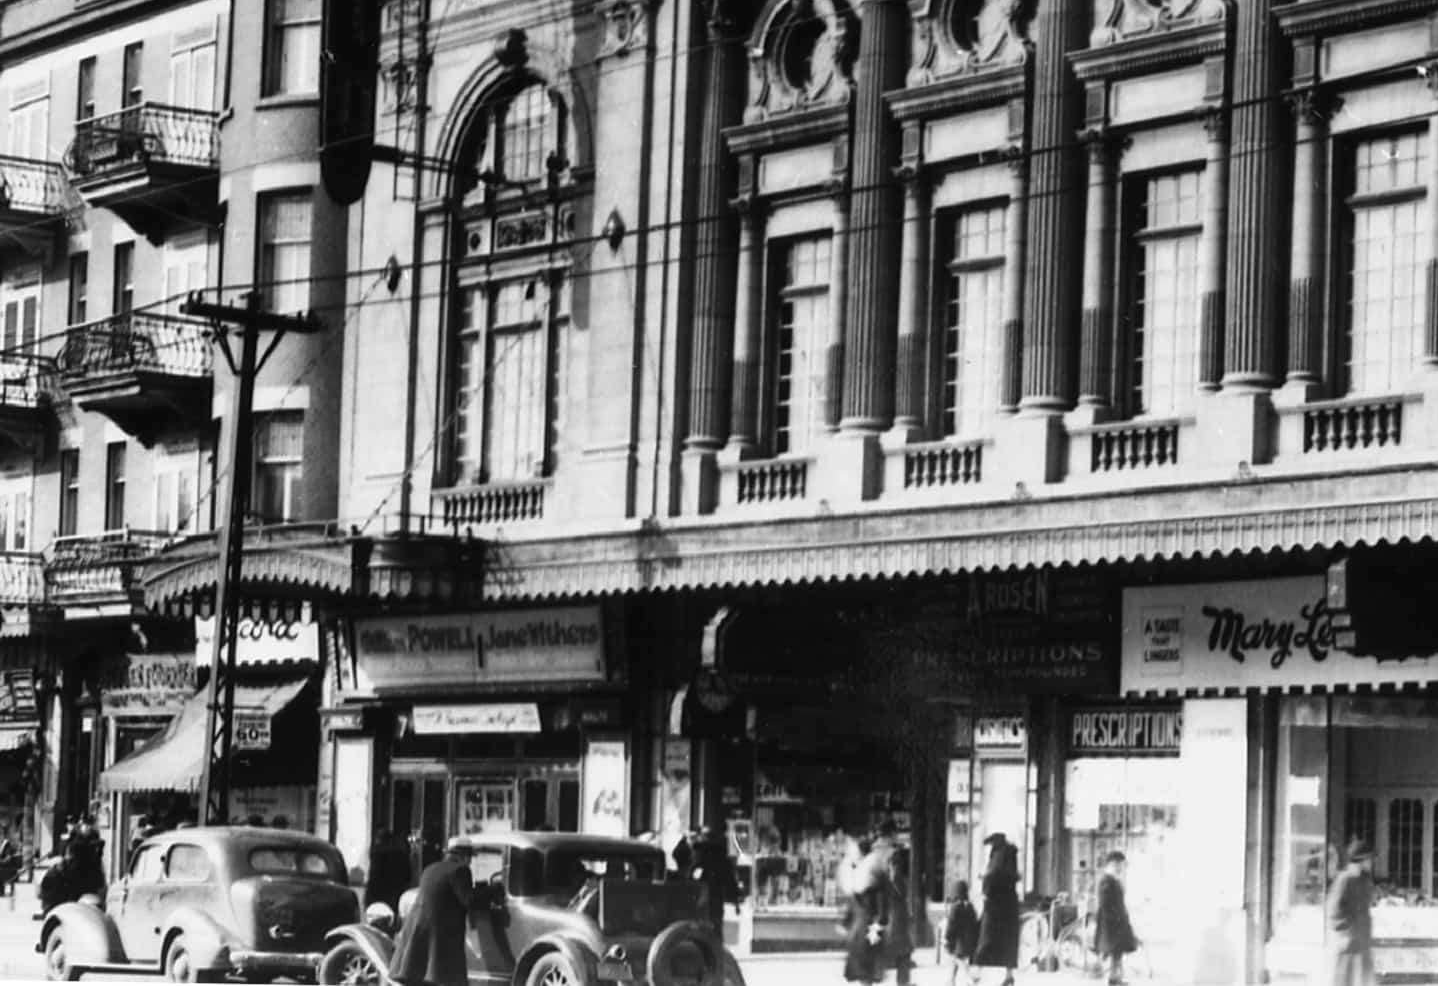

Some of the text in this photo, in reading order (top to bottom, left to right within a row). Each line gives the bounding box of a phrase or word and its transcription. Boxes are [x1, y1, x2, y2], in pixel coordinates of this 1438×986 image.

[985, 567, 1049, 615] ROSEN
[406, 625, 474, 654] POWELL
[1144, 618, 1153, 634] A
[1202, 597, 1337, 669] Mary Le
[236, 728, 259, 741] 60
[1072, 712, 1184, 748] PRESCRIPTIONS
